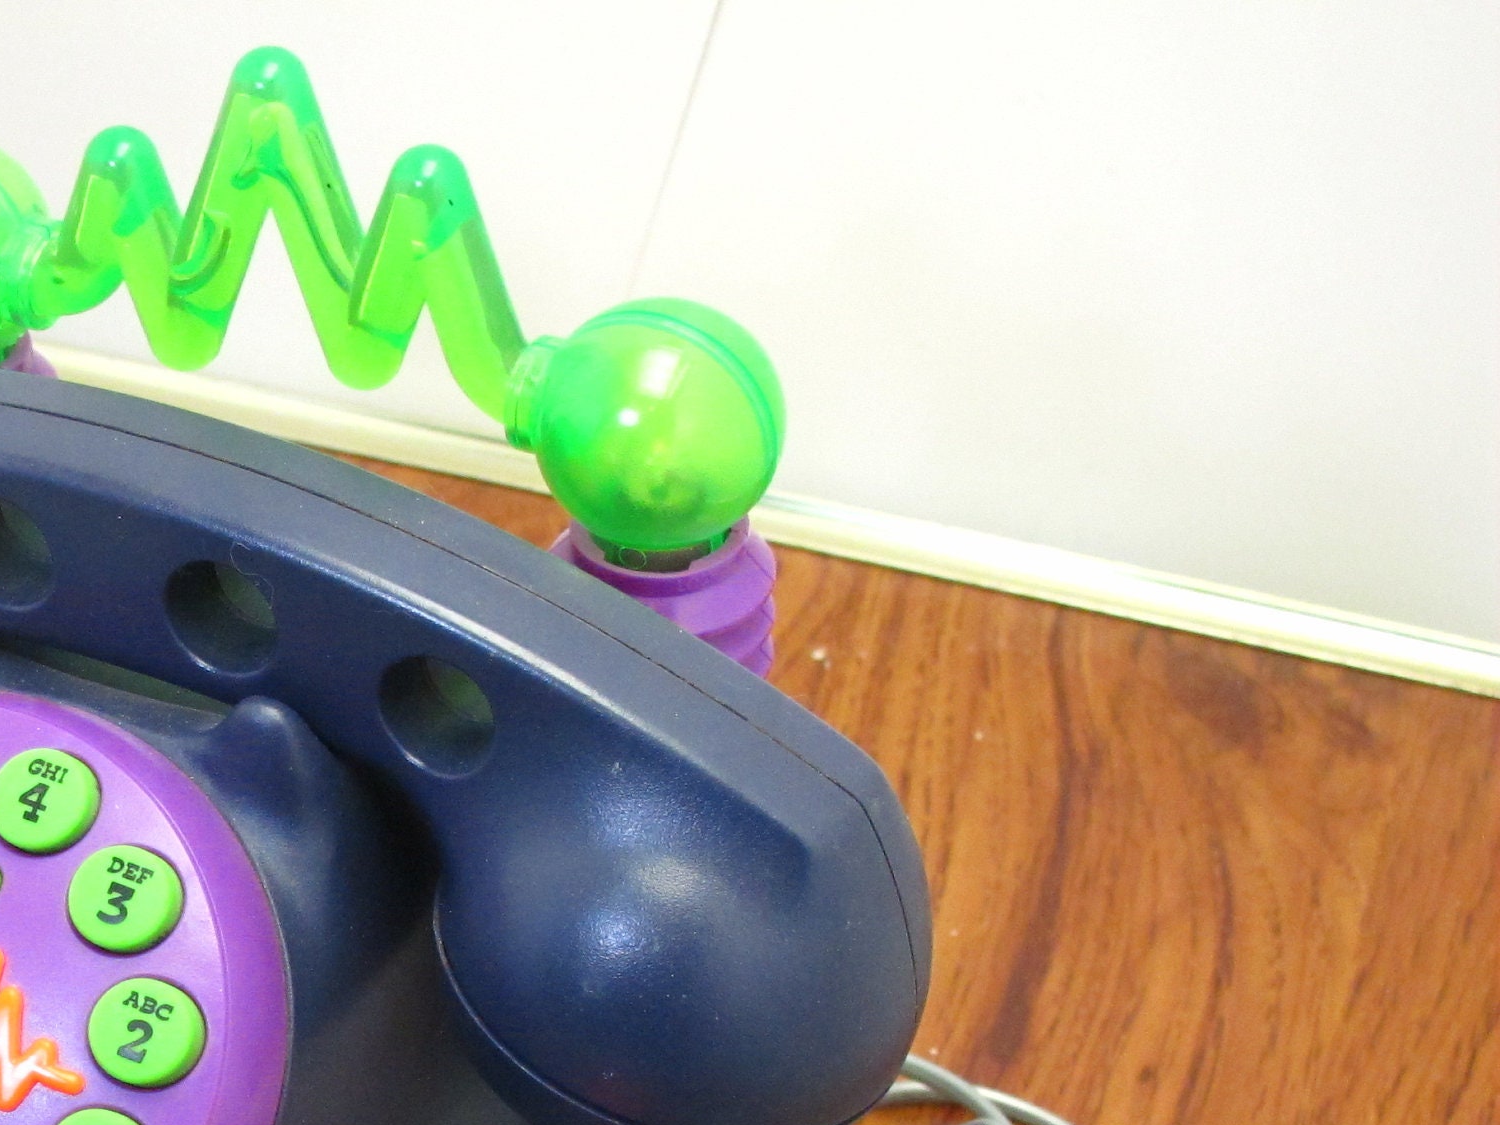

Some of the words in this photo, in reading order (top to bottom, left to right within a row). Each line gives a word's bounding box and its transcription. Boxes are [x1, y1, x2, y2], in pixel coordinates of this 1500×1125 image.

[28, 758, 68, 784] GHI
[18, 783, 50, 823] 4
[106, 856, 155, 885] DEF
[96, 881, 135, 925] 3
[122, 990, 174, 1021] ABC
[116, 1019, 153, 1064] 2
